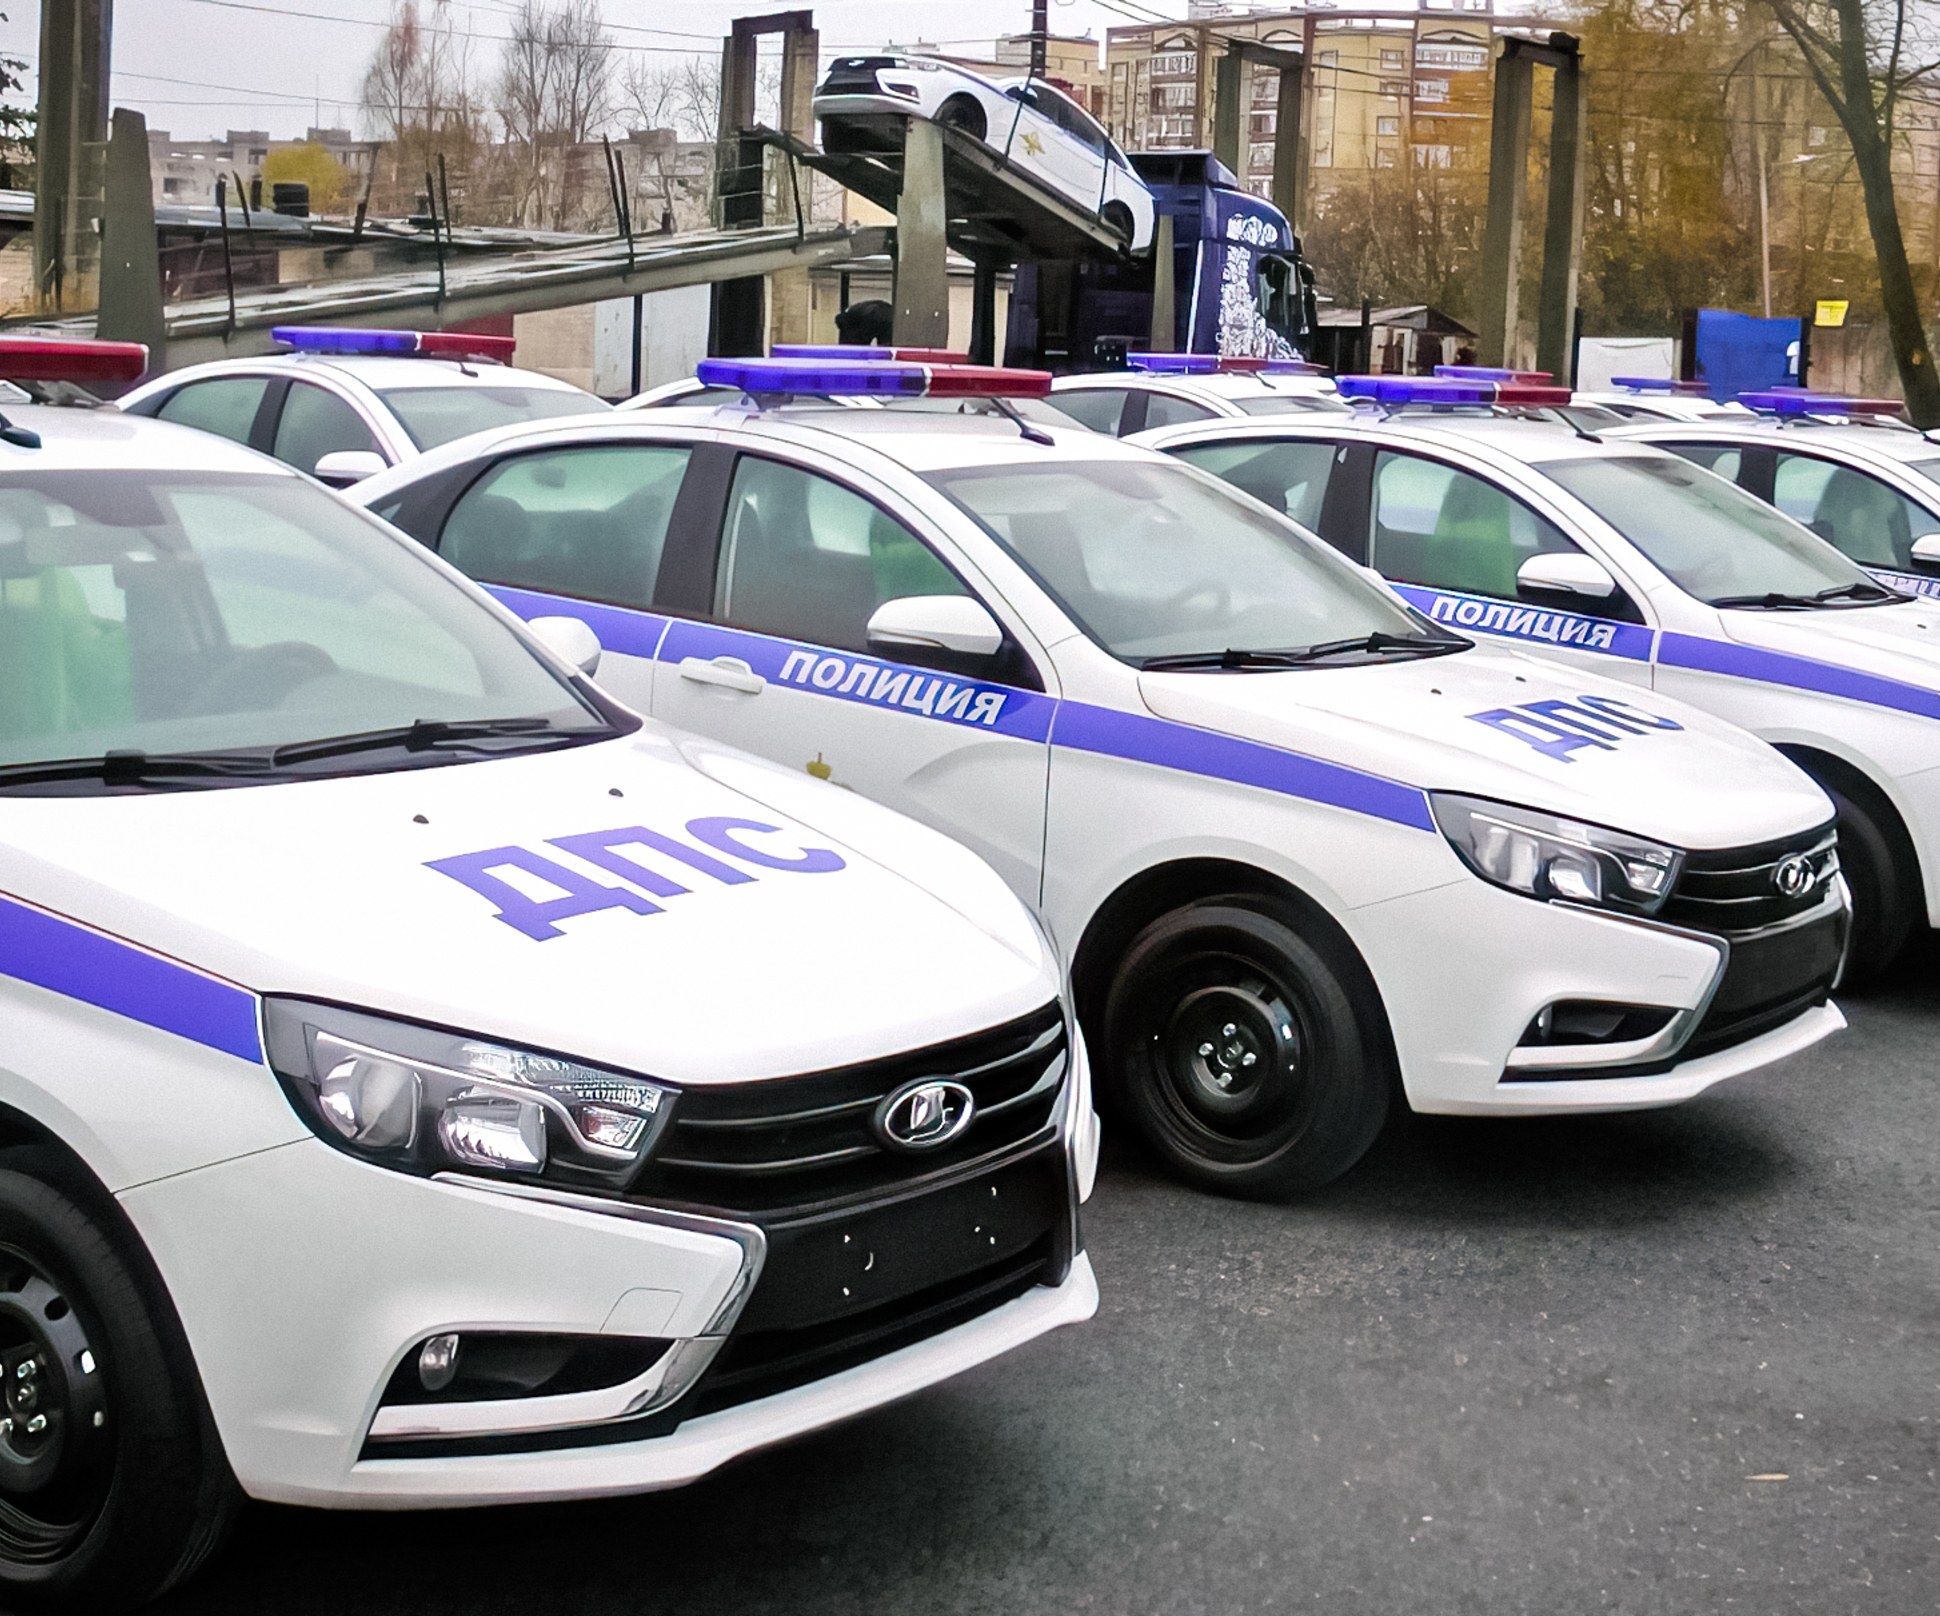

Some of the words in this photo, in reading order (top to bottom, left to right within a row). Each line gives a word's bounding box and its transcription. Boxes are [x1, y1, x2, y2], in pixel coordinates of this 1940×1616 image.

[1430, 595, 1616, 648] ПОЛИЦИЯ
[779, 650, 1007, 725] ПОЛИЦИЯ
[1463, 695, 1684, 764] ДПС
[421, 816, 847, 942] ДПС
